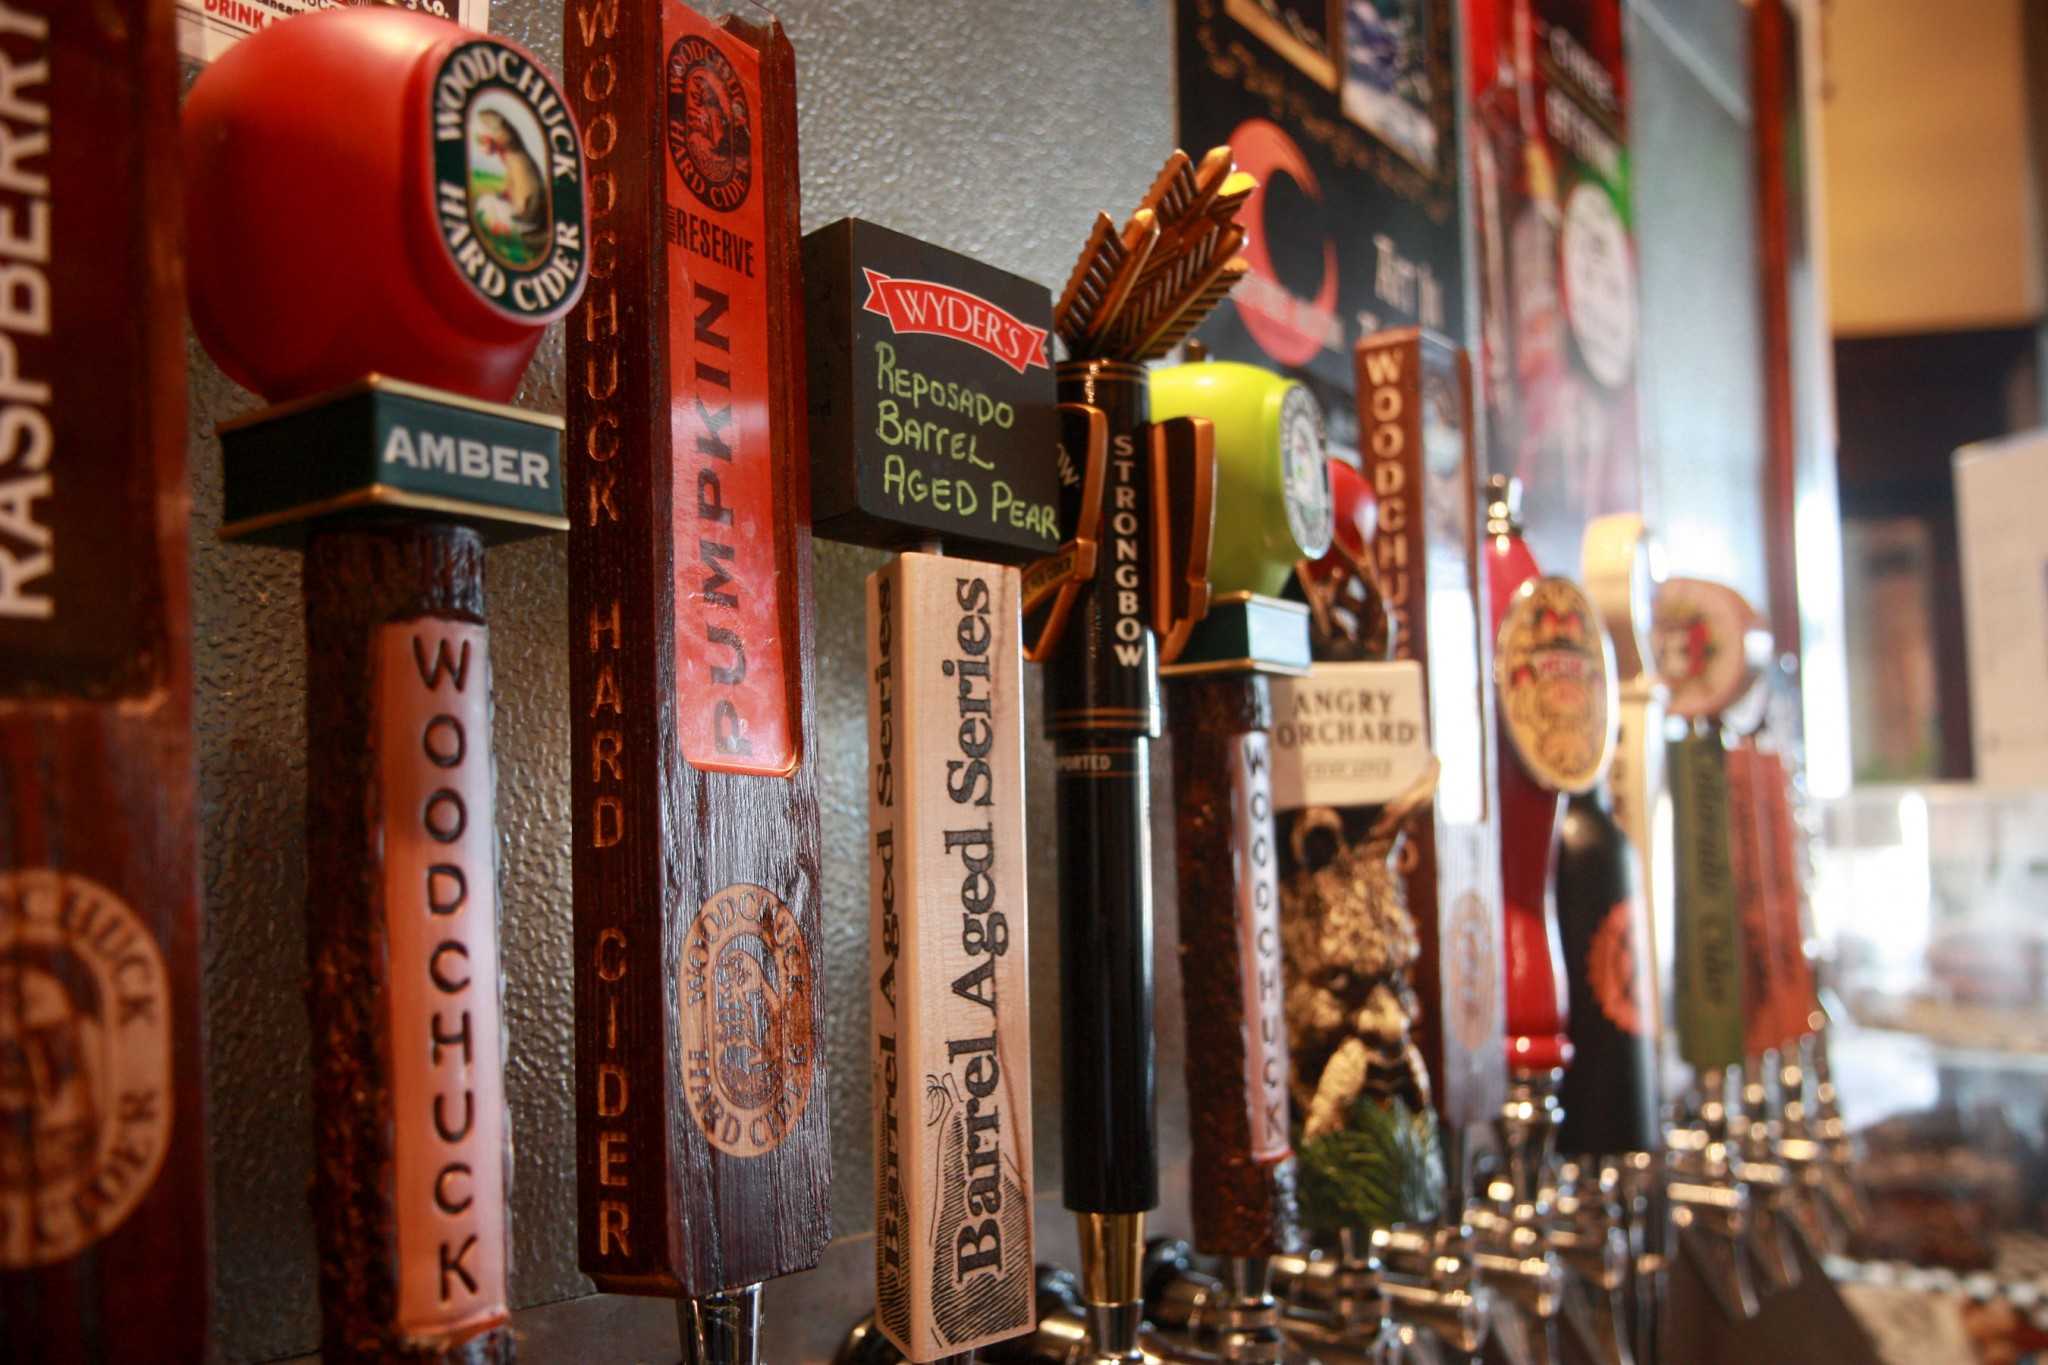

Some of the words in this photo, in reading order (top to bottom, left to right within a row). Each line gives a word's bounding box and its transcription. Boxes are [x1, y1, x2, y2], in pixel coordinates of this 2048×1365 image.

[204, 0, 265, 30] DRINK
[437, 46, 577, 183] WOODCHUCK
[670, 120, 704, 193] HARD
[710, 155, 749, 208] CIDER
[439, 181, 506, 297] HARD
[512, 221, 580, 311] CIDER
[577, 0, 619, 528] WOODCHUCK
[675, 207, 755, 278] RESERVE
[895, 288, 1022, 360] WYDER'S
[383, 425, 549, 489] AMBER
[875, 341, 1014, 429] REPOSADO
[694, 280, 754, 757] PUMPKIN
[884, 454, 978, 516] AGED
[992, 480, 1060, 541] PEAR
[1112, 434, 1144, 667] STRONGBOW
[589, 601, 625, 848] HARD
[875, 576, 893, 808] Series
[942, 576, 995, 807] Series
[1276, 720, 1418, 749] ORCHARD
[1292, 688, 1393, 719] ANGRY
[412, 633, 478, 1302] WOODCHUCK
[876, 822, 899, 1019] Aged
[943, 822, 1009, 1017] Aged
[1243, 741, 1284, 1142] WOODCHUCK
[595, 927, 632, 1258] CIDER
[879, 1034, 901, 1277] Barrel
[949, 1029, 1003, 1285] Barrel
